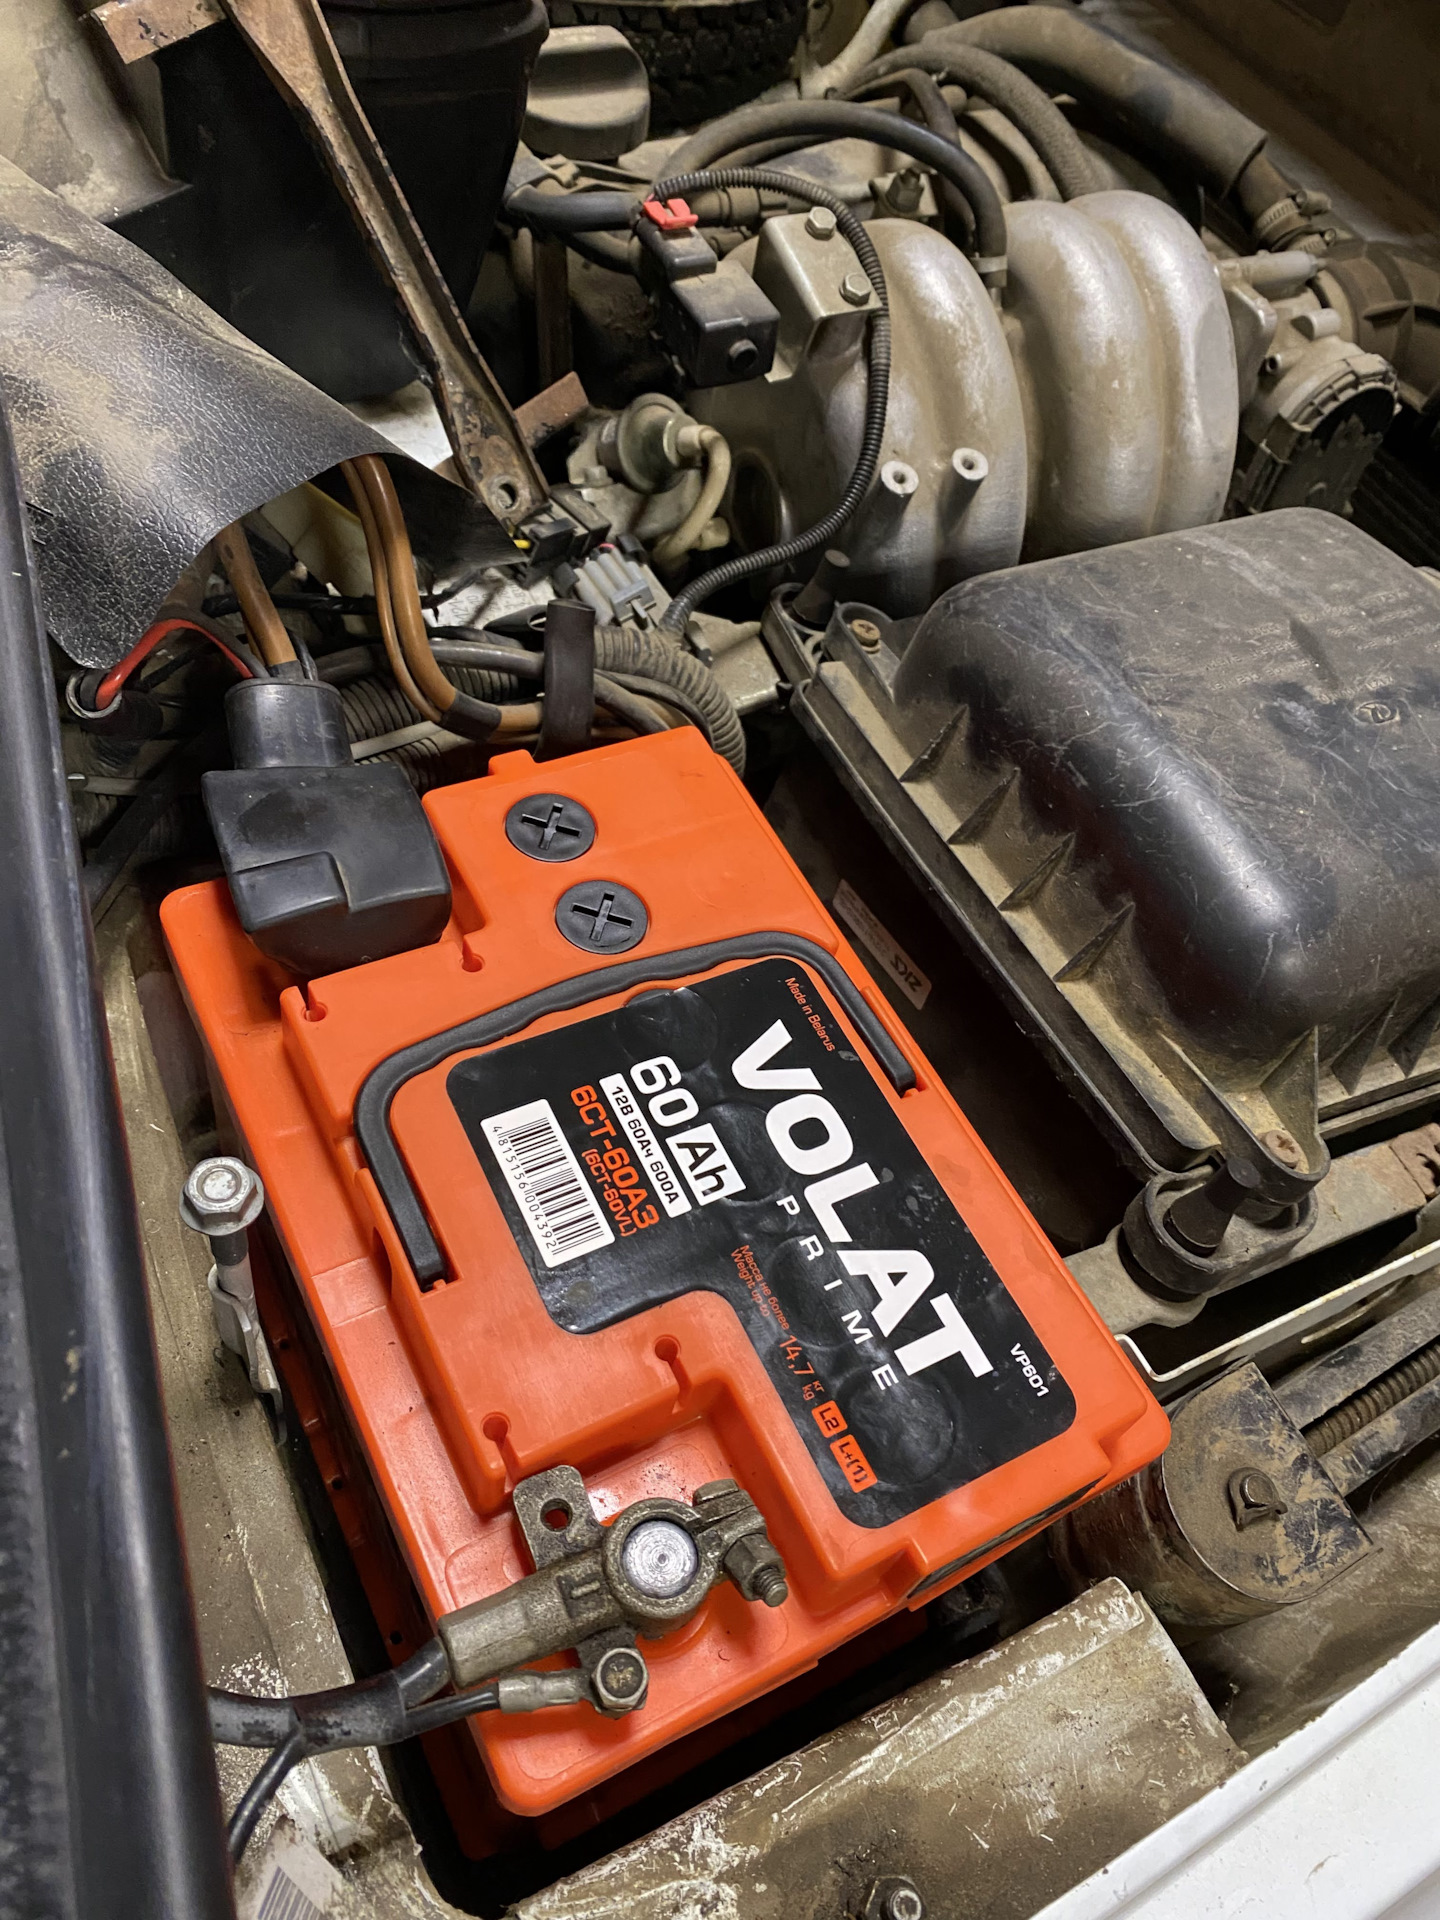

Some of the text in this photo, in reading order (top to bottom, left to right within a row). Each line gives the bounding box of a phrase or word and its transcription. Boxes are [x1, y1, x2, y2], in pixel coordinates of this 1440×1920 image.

[785, 977, 835, 1051] Made in Belarus
[631, 1056, 727, 1196] 60 Ah
[732, 1019, 993, 1377] VOLAT
[731, 1248, 756, 1289] Weight
[738, 1245, 789, 1330] Масса не более
[777, 1195, 899, 1390] PRIME
[779, 1335, 815, 1375] 14,7
[1011, 1343, 1048, 1396] VP601
[802, 1383, 815, 1401] kg
[820, 1408, 839, 1430] L2
